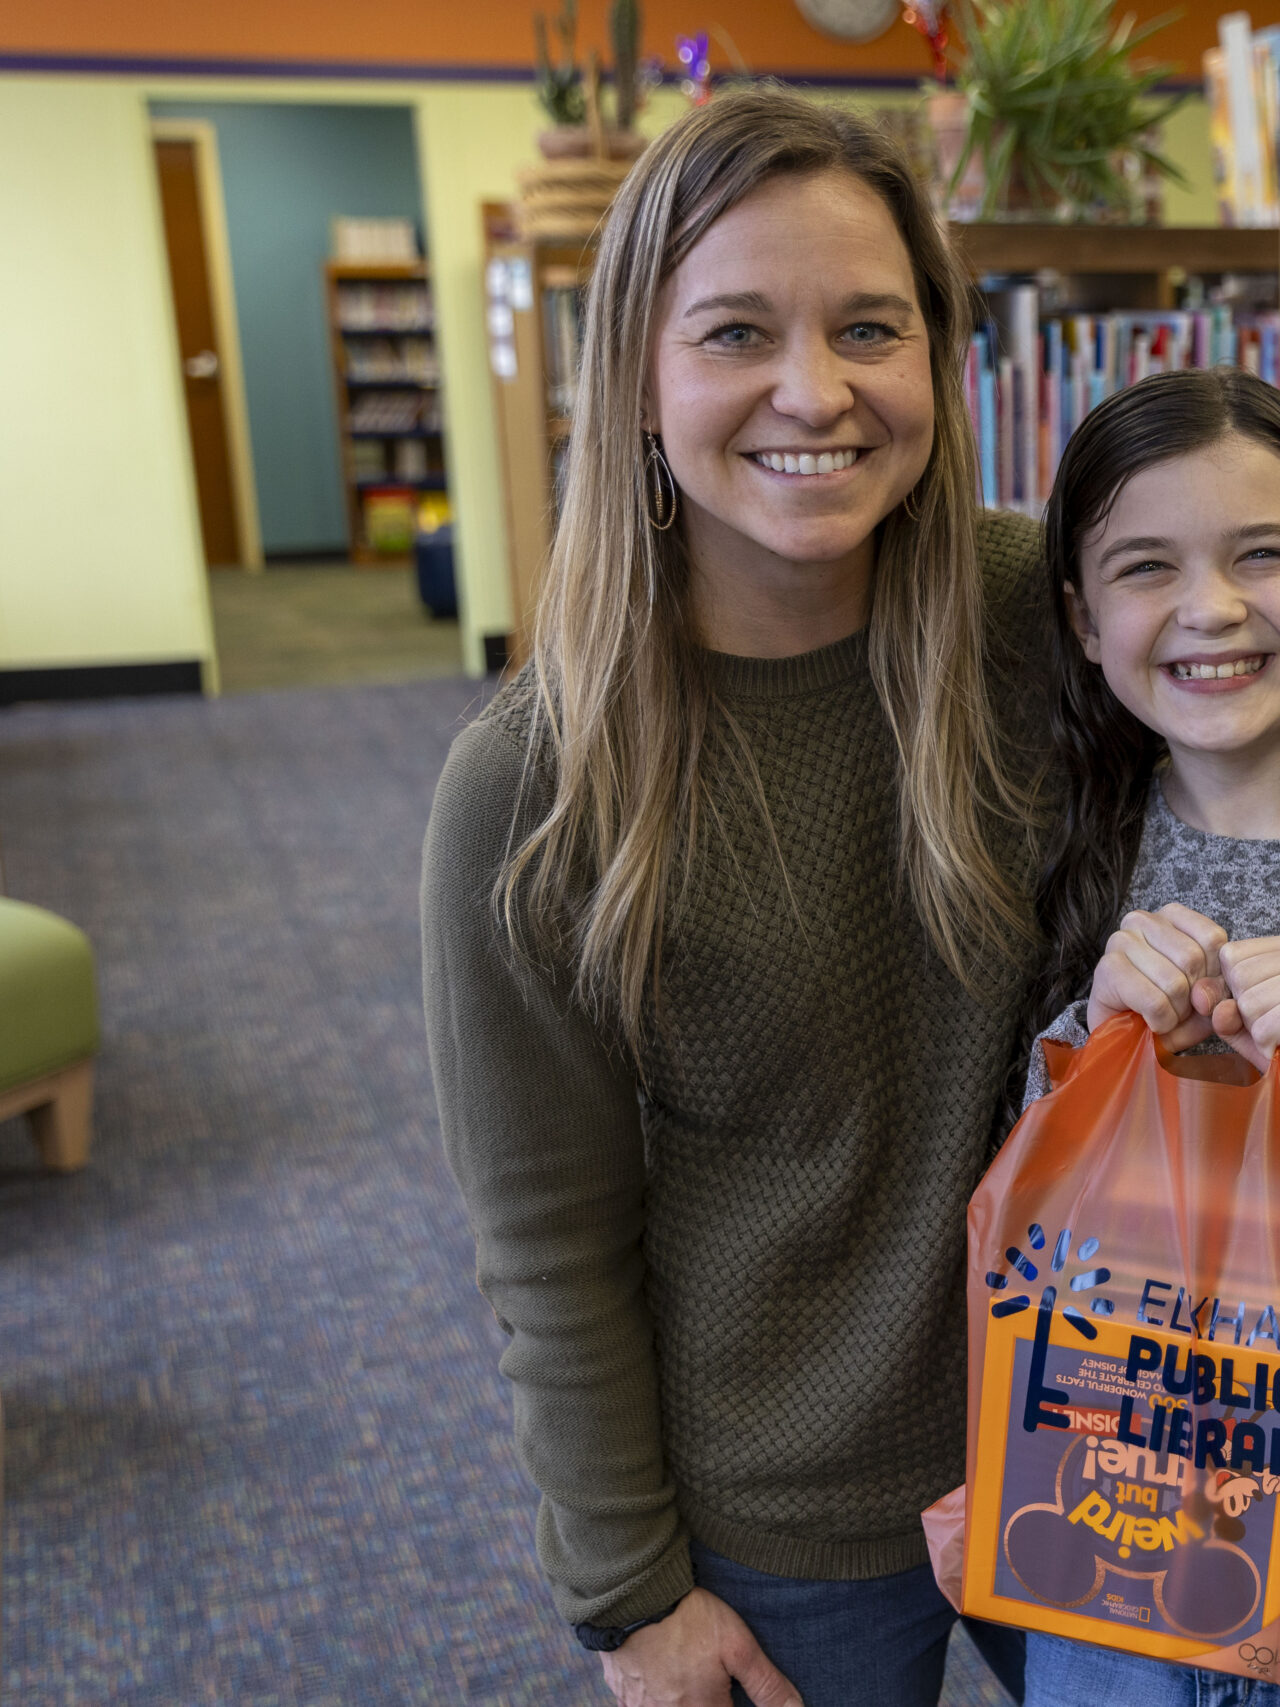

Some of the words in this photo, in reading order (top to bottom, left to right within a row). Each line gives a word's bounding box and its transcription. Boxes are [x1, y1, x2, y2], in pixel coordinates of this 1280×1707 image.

[1081, 1358, 1117, 1373] DISNEY
[1056, 1374, 1085, 1388] FACTS
[1078, 1368, 1098, 1380] THE
[1137, 1369, 1163, 1381] MAGI
[1086, 1379, 1148, 1401] WONDERFUL
[1082, 1436, 1192, 1497] true!
[1115, 1481, 1159, 1513] but
[1066, 1489, 1205, 1560] weird
[1109, 1607, 1138, 1620] NATIONAL
